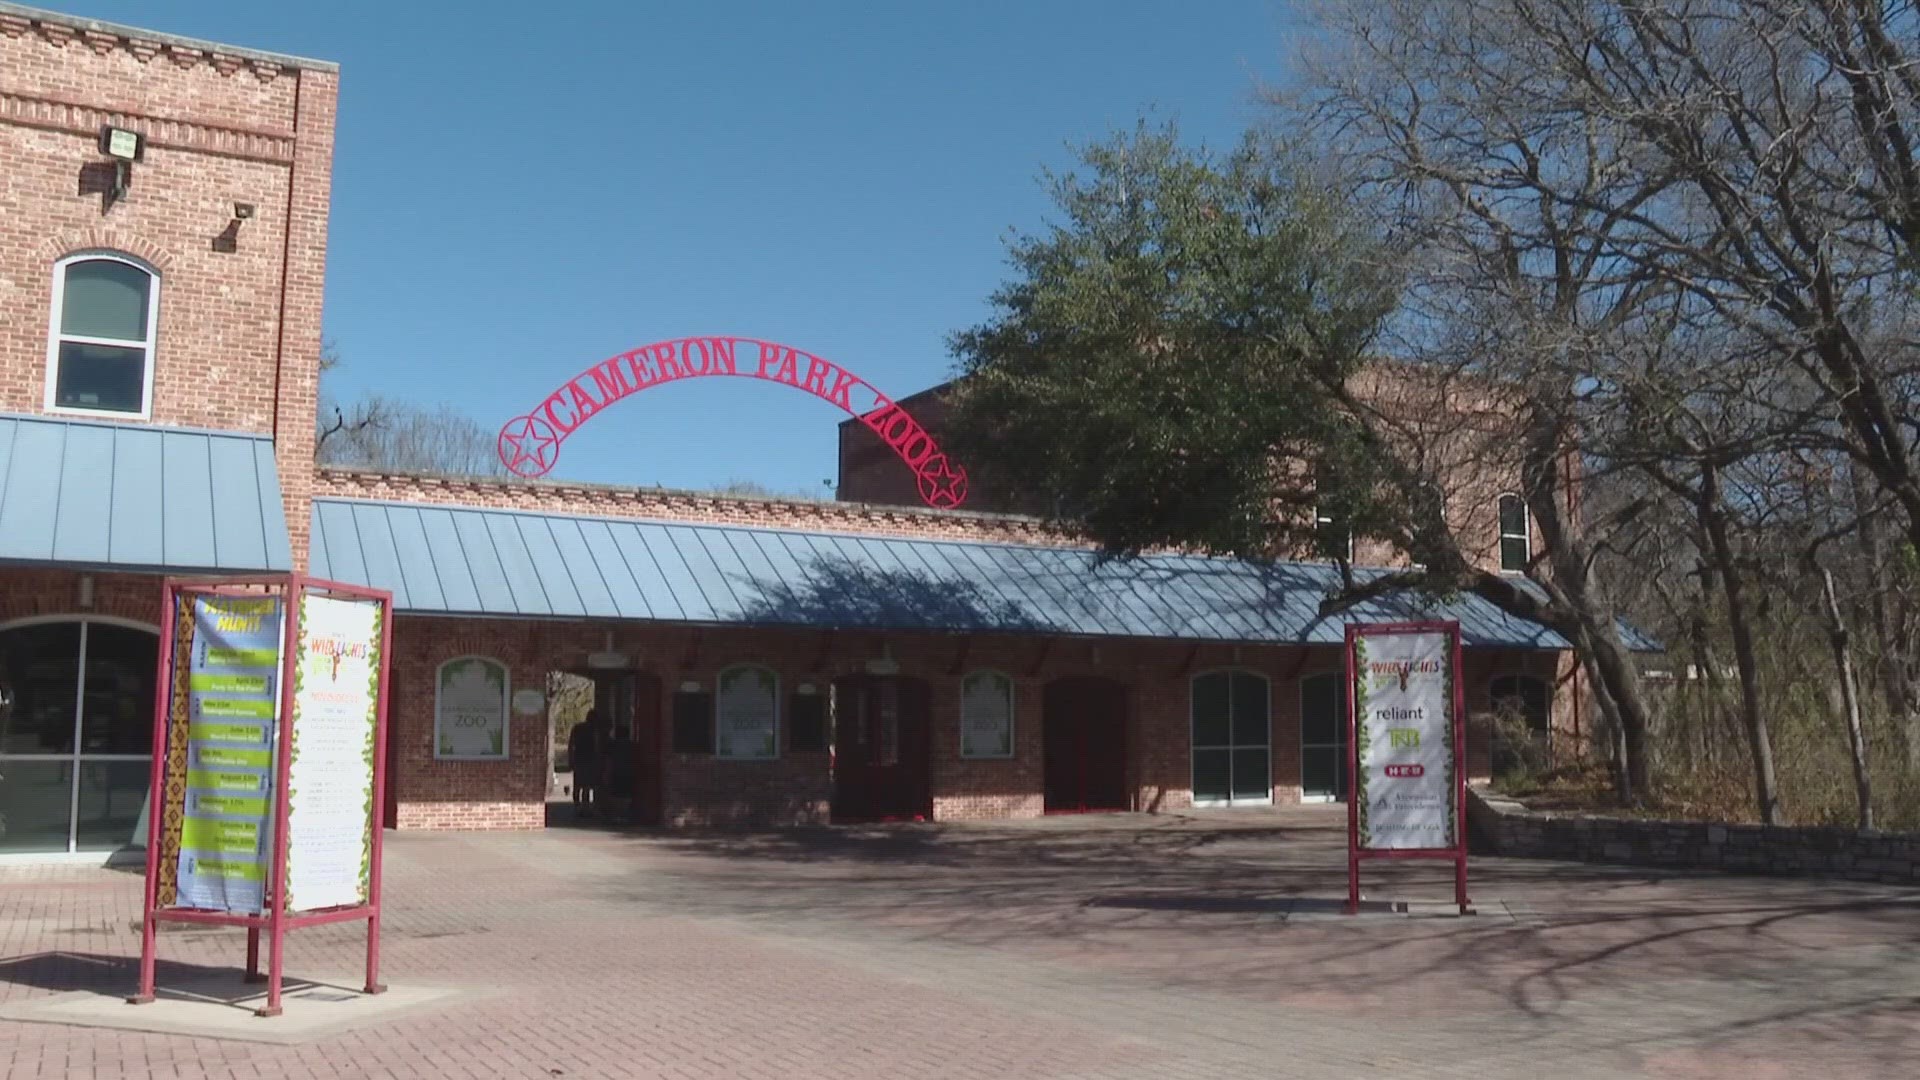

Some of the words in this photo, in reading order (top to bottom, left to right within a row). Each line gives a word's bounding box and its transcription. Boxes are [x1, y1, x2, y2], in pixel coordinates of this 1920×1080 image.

[544, 337, 737, 434] CAMERON
[756, 340, 860, 409] PARK
[862, 394, 937, 468] ZOO
[1376, 706, 1424, 720] reliant
[455, 714, 487, 727] ZOO
